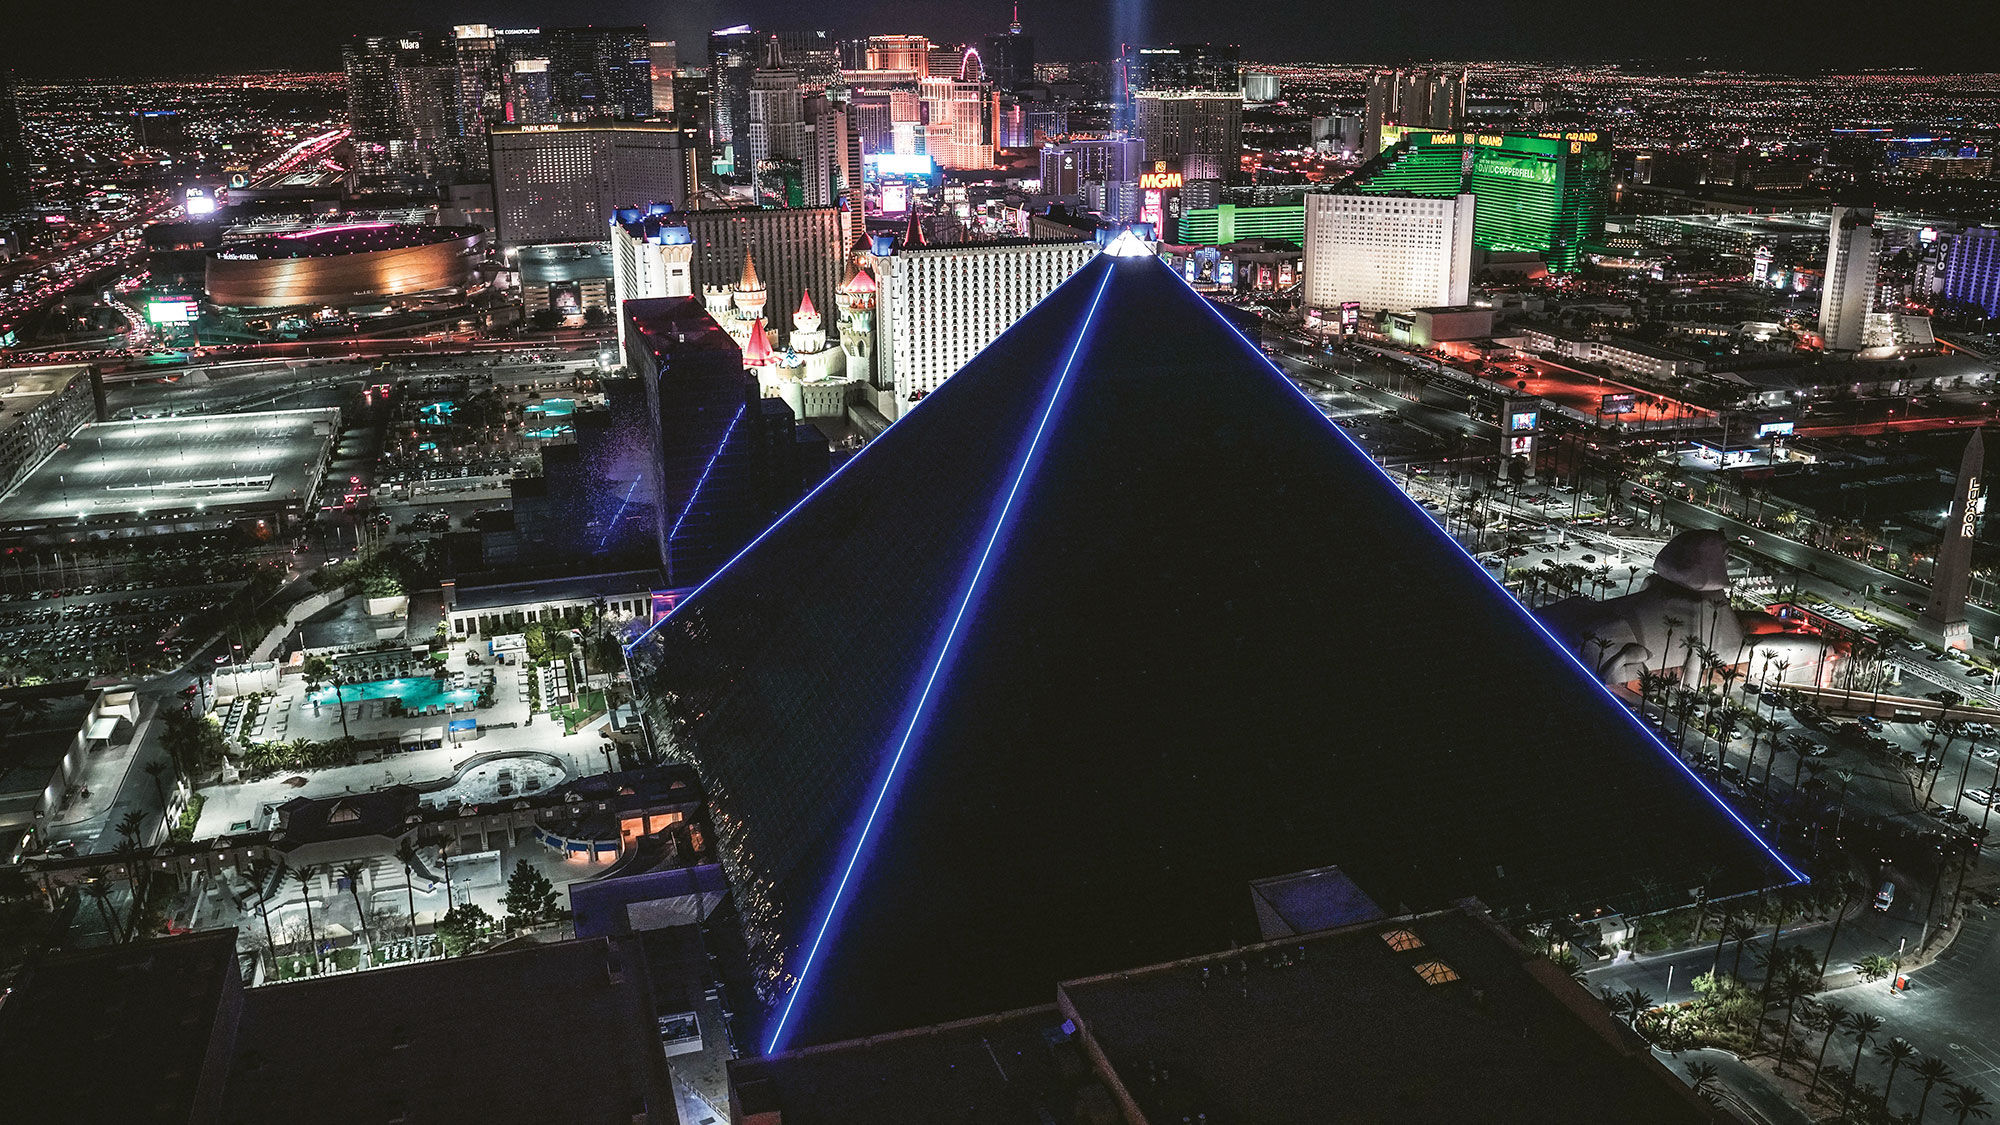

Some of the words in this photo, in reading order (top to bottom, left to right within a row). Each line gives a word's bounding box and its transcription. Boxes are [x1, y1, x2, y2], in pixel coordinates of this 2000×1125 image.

[400, 39, 420, 50] Vdara
[540, 124, 559, 132] MGM
[1431, 134, 1456, 145] MGM
[1479, 135, 1503, 147] GRAND
[1565, 132, 1598, 143] GRAND
[1140, 173, 1182, 189] MGM
[1937, 243, 1948, 271] OYO
[1961, 477, 1980, 538] LUXOR
